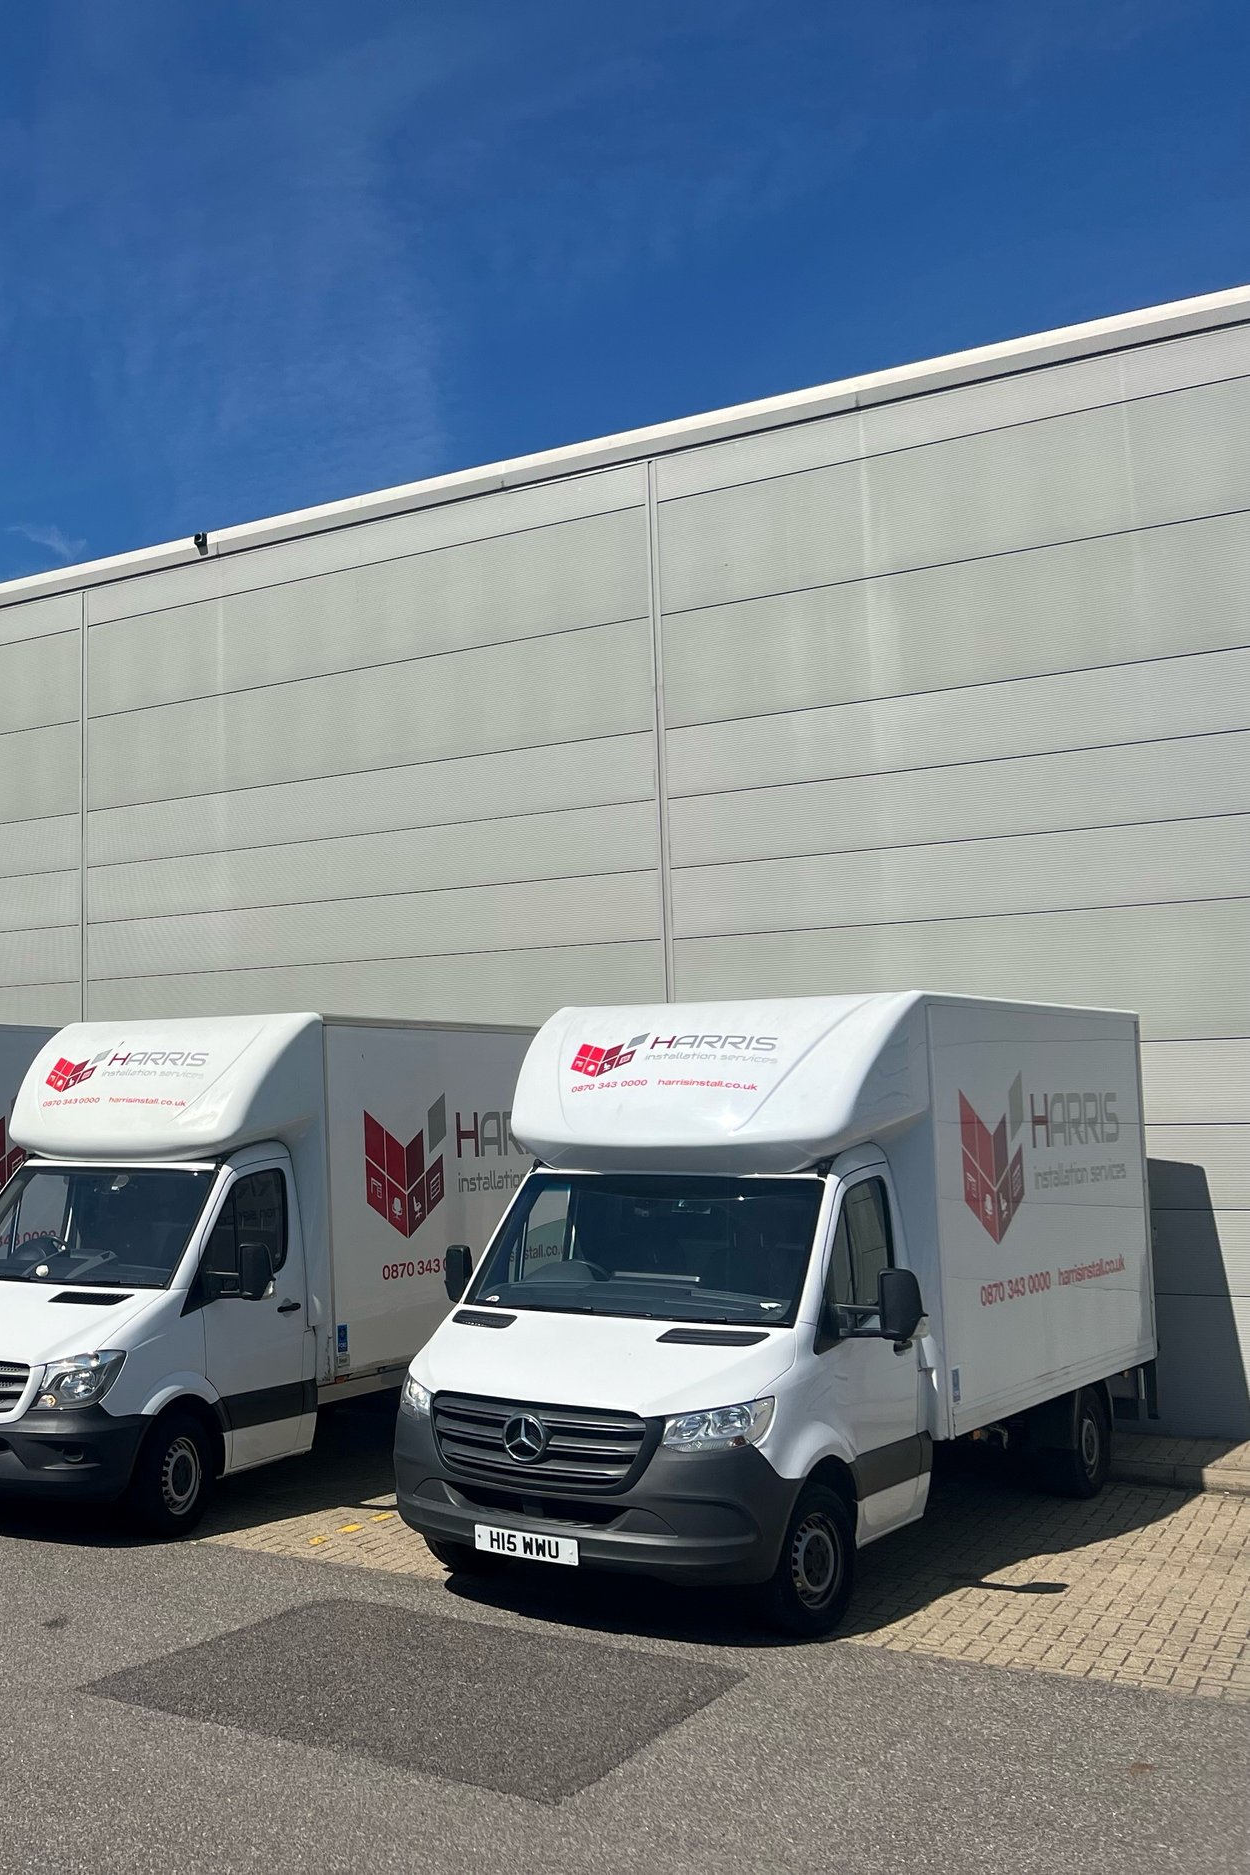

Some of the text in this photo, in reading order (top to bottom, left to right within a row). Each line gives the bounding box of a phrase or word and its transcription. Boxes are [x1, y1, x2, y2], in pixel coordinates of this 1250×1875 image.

[650, 1034, 778, 1051] HARRIS
[108, 1052, 209, 1067] HARRIS
[645, 1051, 778, 1064] installation services
[102, 1068, 204, 1080] installation services
[571, 1078, 758, 1093] 0870 343 0000 harrisinstall.co.uk
[62, 1098, 78, 1106] 343
[108, 1097, 186, 1107] harrisinstall.co.uk
[1030, 1092, 1120, 1149] HARRIS
[455, 1111, 529, 1158] HAR
[1034, 1160, 1127, 1190] installation services
[382, 1261, 415, 1281] 0870
[417, 1260, 441, 1277] 343
[980, 1254, 1126, 1306] 0870 343 0000 harrisinstall.co.uk
[522, 1536, 559, 1559] WWU
